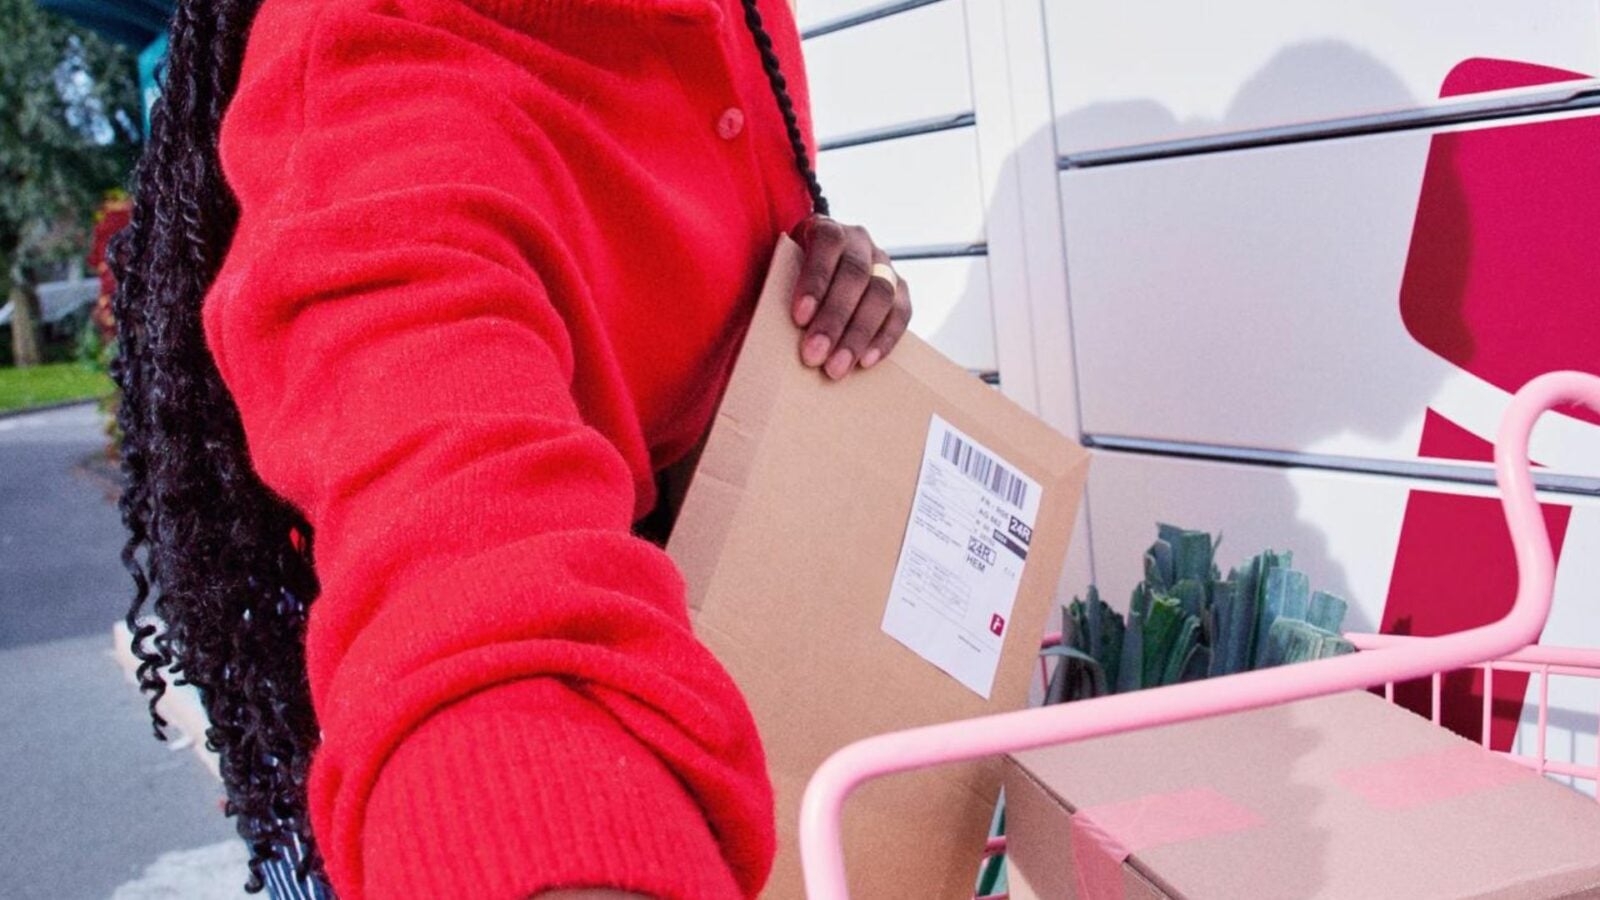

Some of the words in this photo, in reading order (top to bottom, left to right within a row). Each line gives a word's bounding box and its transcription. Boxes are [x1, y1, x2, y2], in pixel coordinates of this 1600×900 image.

[1009, 518, 1031, 542] 24R
[967, 554, 986, 572] HEM
[968, 538, 991, 564] 24R
